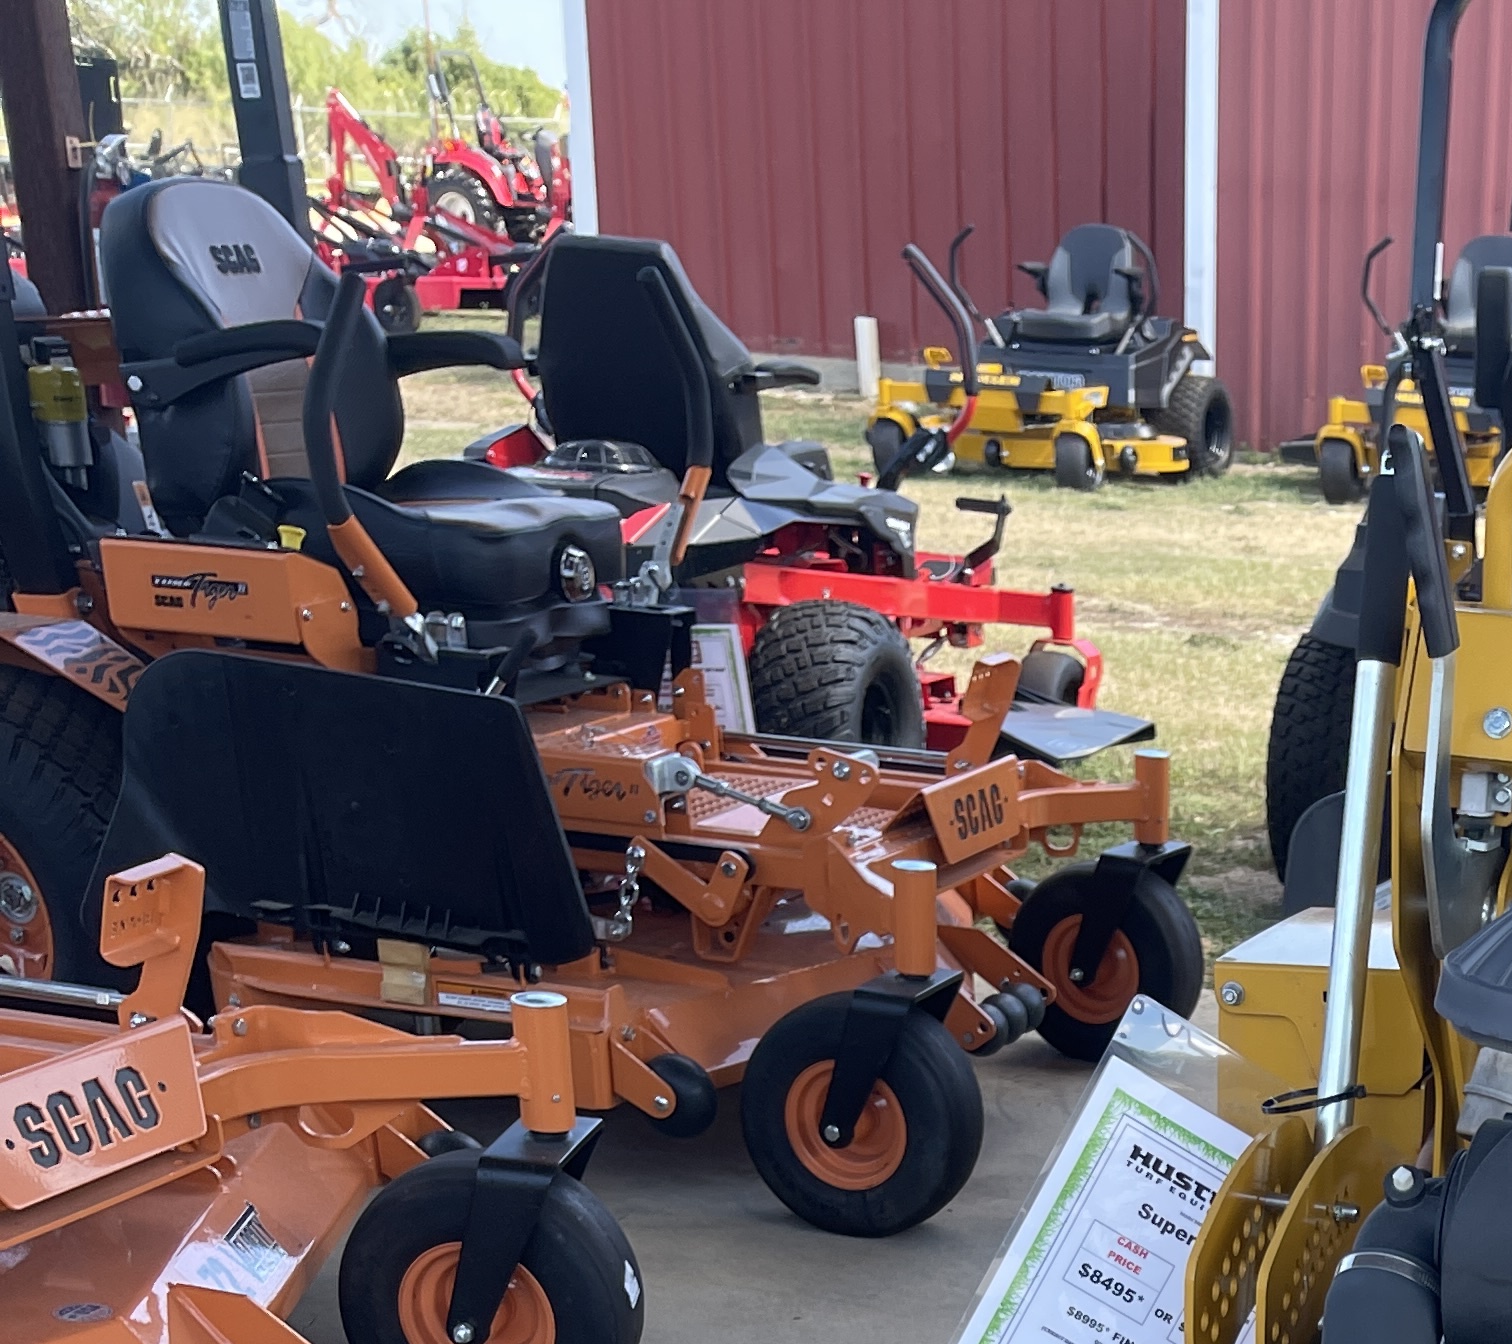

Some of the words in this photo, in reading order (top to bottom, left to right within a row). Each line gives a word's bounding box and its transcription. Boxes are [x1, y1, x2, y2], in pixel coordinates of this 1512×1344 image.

[209, 244, 261, 274] SCAG
[954, 783, 1004, 840] SCAG
[13, 1065, 161, 1169] SCAG
[1126, 1160, 1163, 1185] TURF
[1169, 1186, 1208, 1211] EQUI
[1129, 1144, 1218, 1204] HUST
[1115, 1235, 1149, 1259] CASH
[1137, 1203, 1198, 1247] Super
[1106, 1249, 1143, 1276] PRICE
[1153, 1307, 1174, 1324] OR
